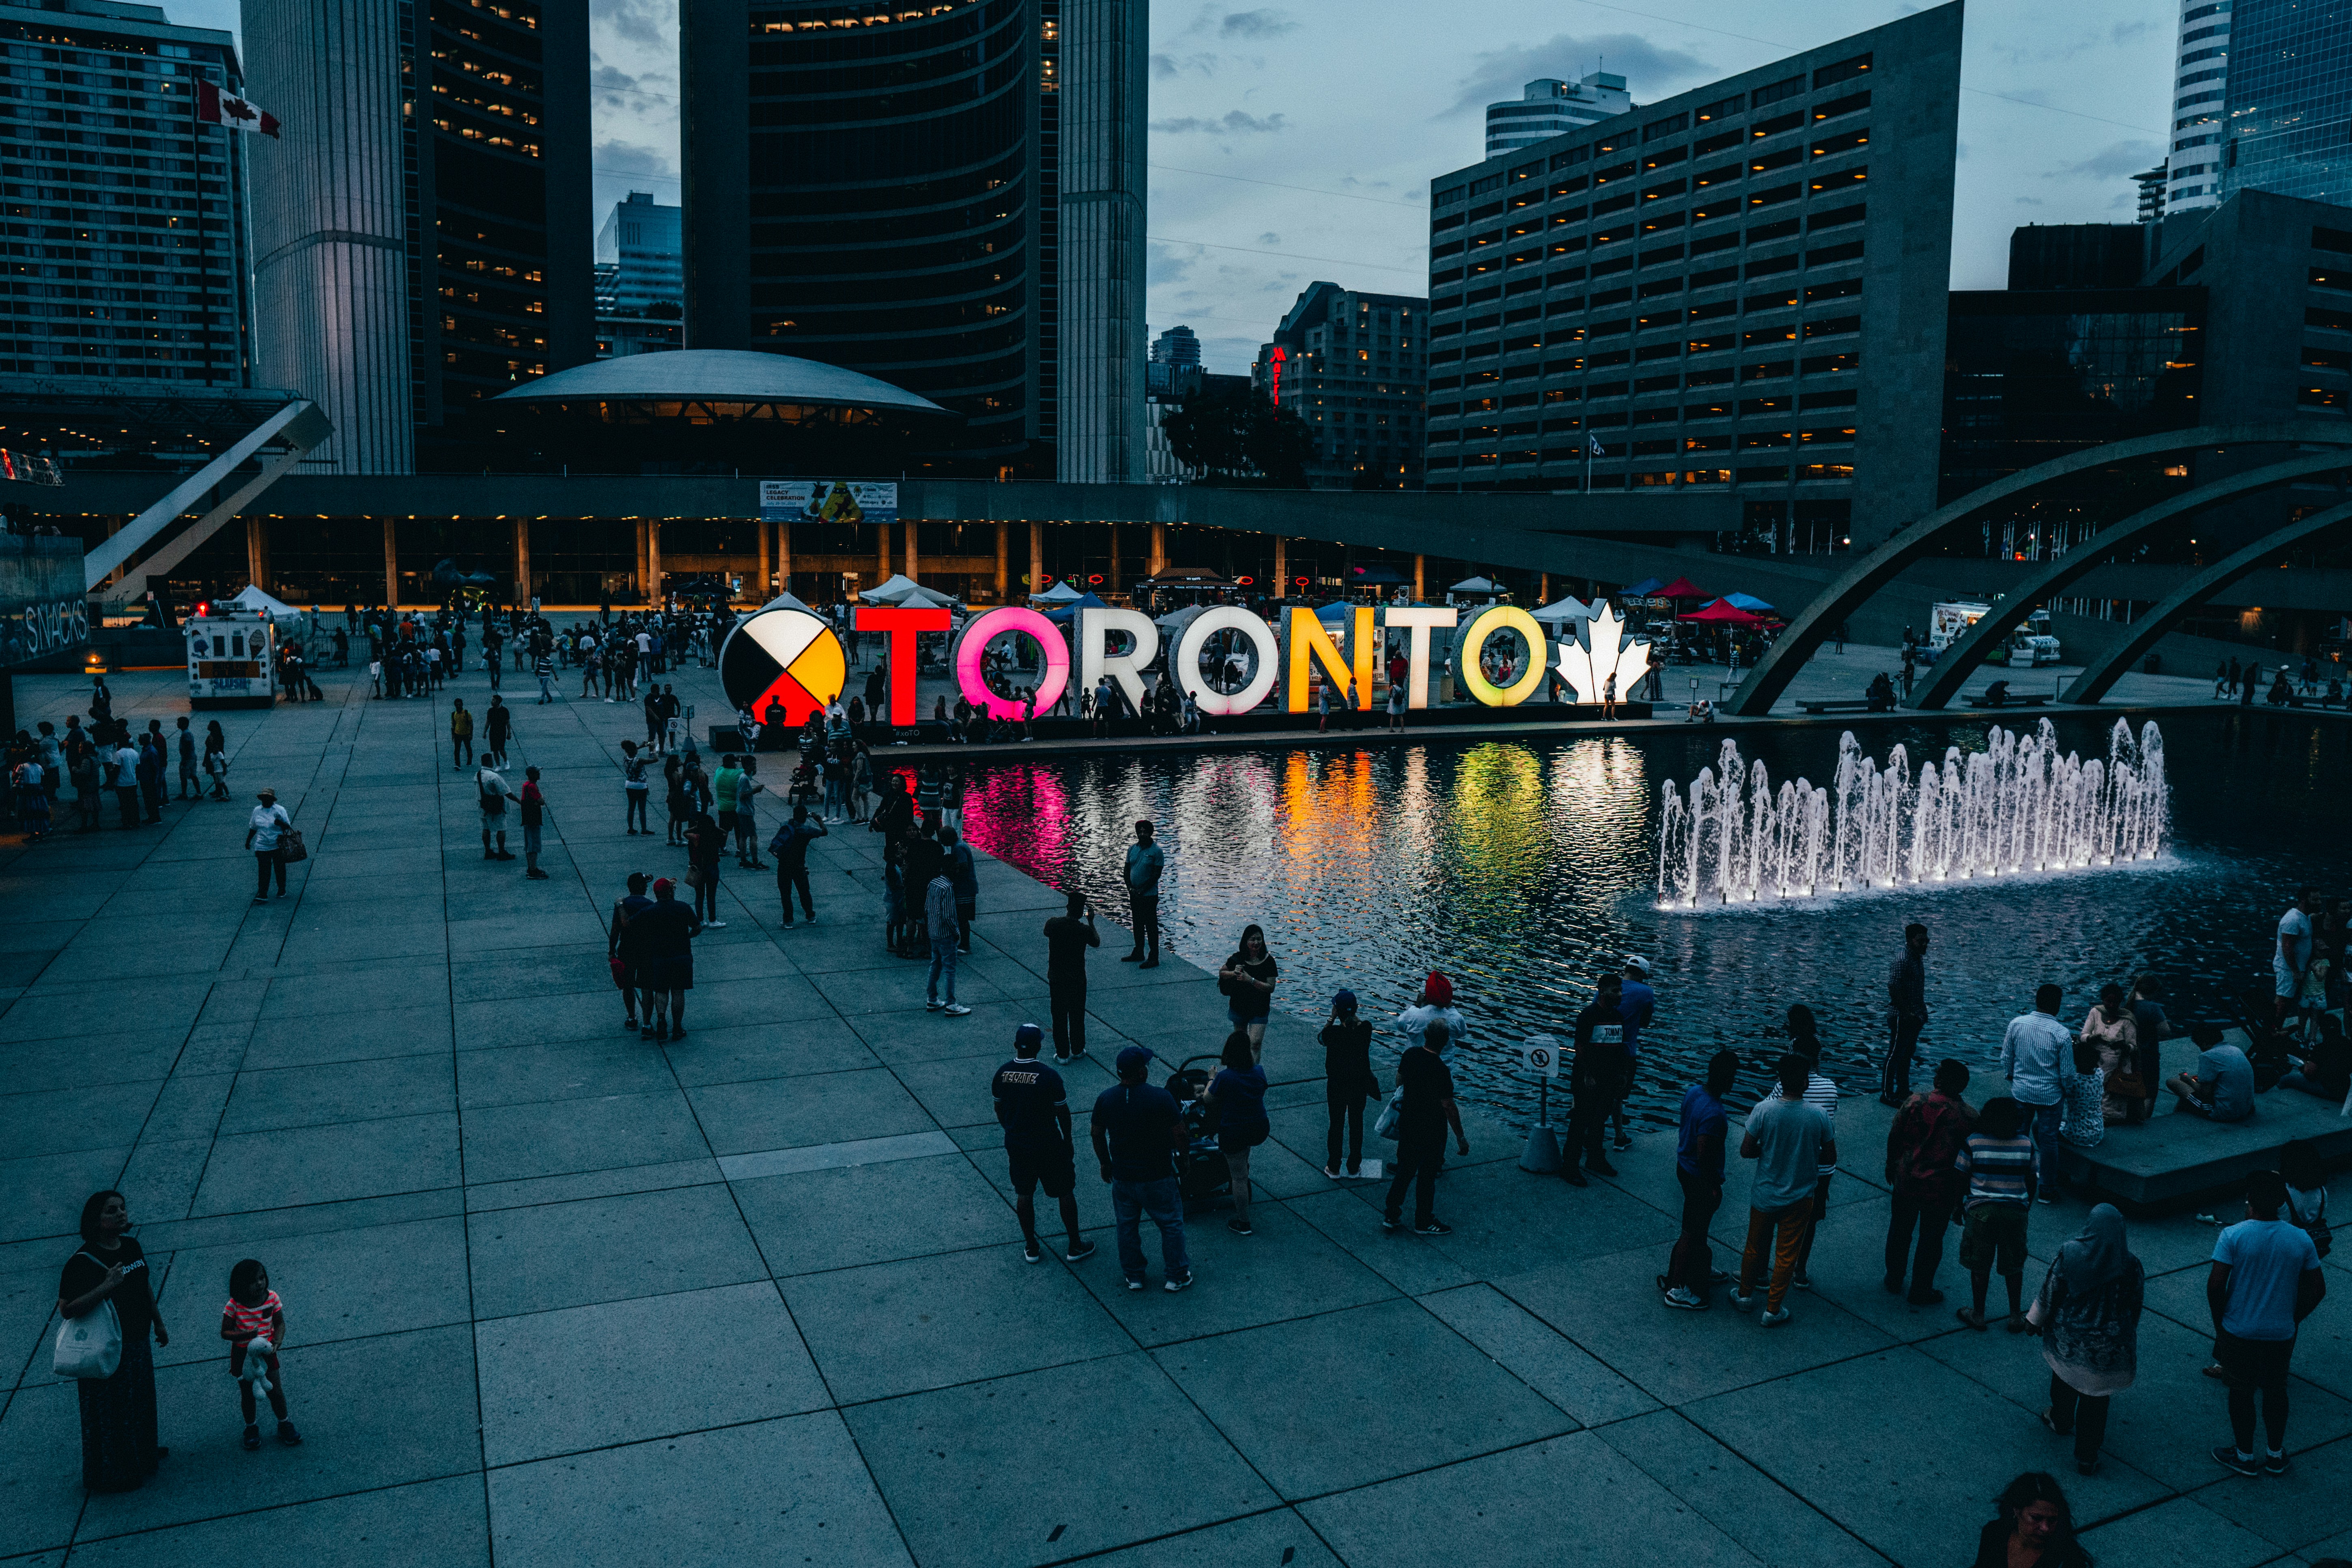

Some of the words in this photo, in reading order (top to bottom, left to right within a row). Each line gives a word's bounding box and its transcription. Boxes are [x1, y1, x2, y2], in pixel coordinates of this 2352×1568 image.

[1270, 347, 1287, 421] Marri
[26, 599, 87, 653] SNACKS
[855, 604, 1547, 726] TORONTO
[1604, 1028, 1623, 1036] TOMMY
[1001, 1071, 1039, 1084] TECATE
[123, 1259, 145, 1274] bway
